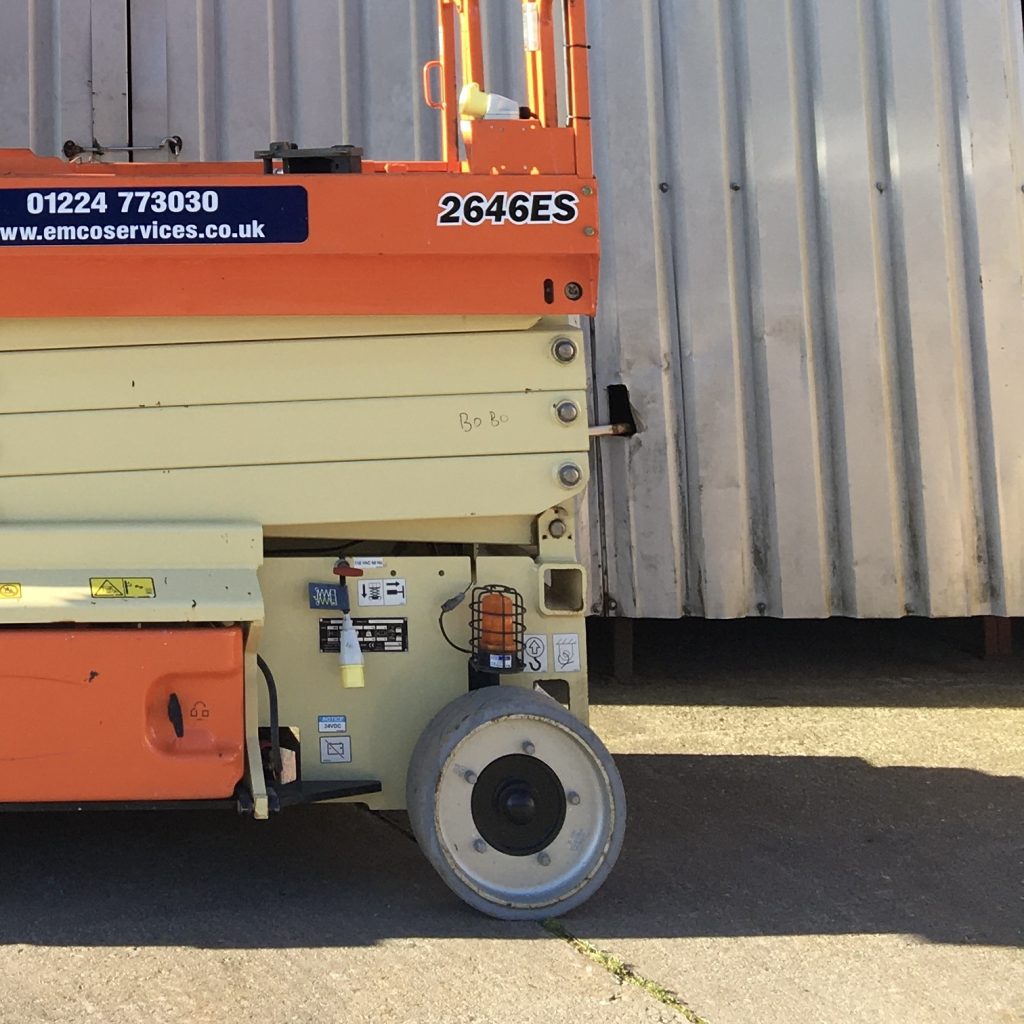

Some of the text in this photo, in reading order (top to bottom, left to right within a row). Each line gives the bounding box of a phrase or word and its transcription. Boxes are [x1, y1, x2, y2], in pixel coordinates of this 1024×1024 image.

[26, 190, 219, 215] 01224 773030
[436, 192, 578, 225] 2646ES
